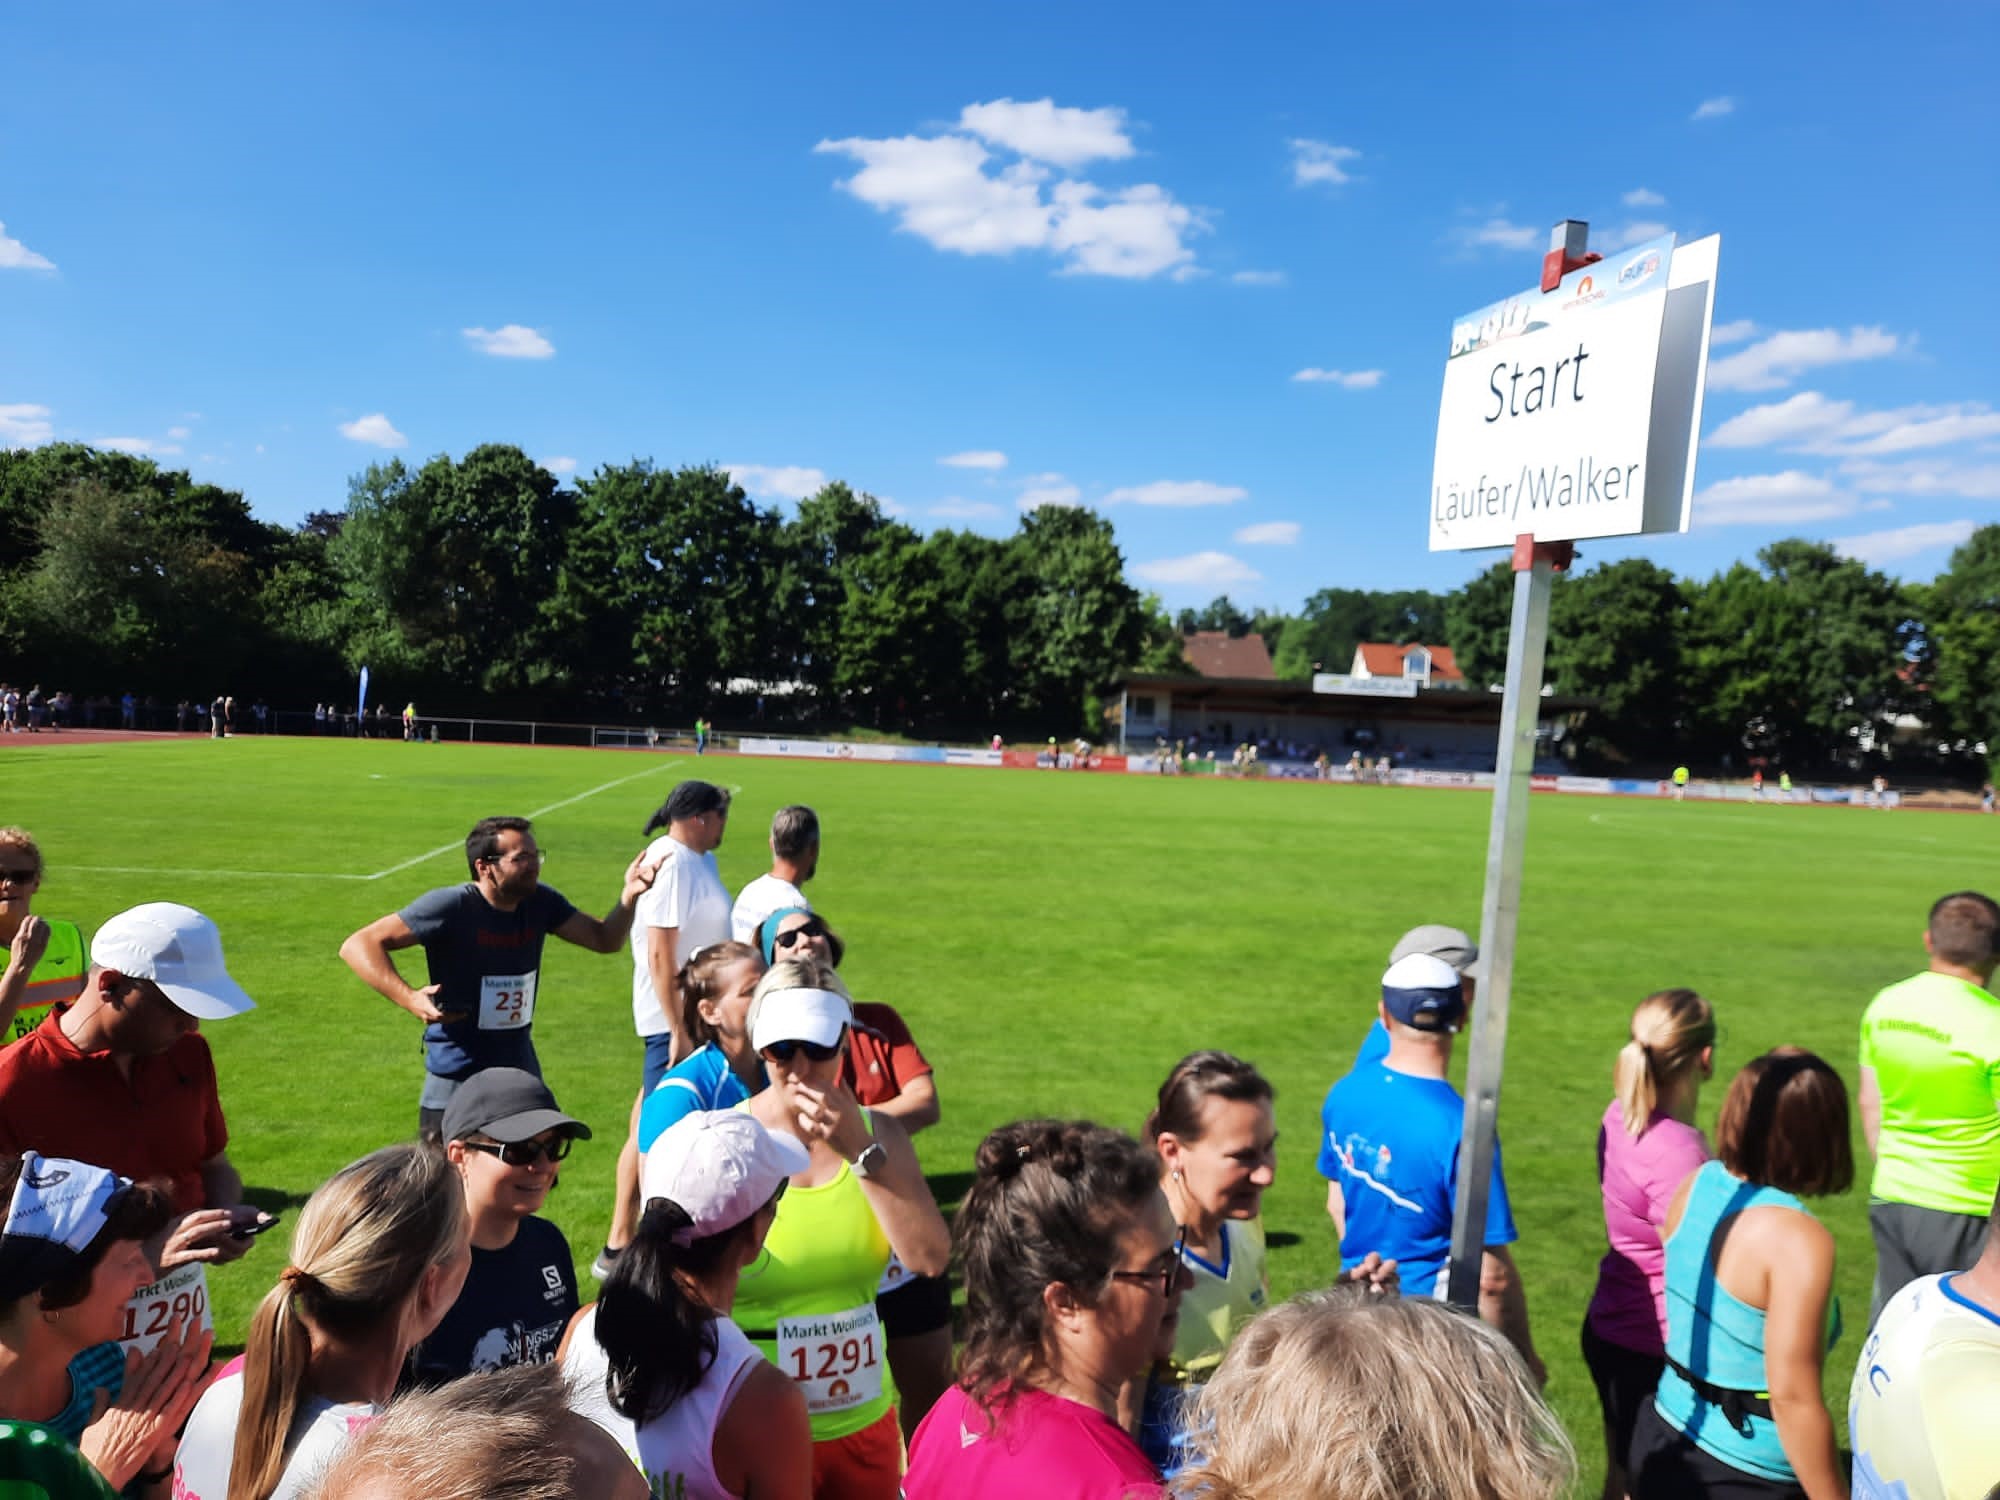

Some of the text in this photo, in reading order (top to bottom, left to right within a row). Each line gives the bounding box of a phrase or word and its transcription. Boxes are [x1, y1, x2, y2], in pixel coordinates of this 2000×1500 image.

[1485, 343, 1589, 423] Start
[1435, 456, 1639, 521] Läufer/Walker
[117, 1285, 204, 1342] 1290
[783, 1323, 827, 1339] Markt
[790, 1333, 876, 1381] 1291
